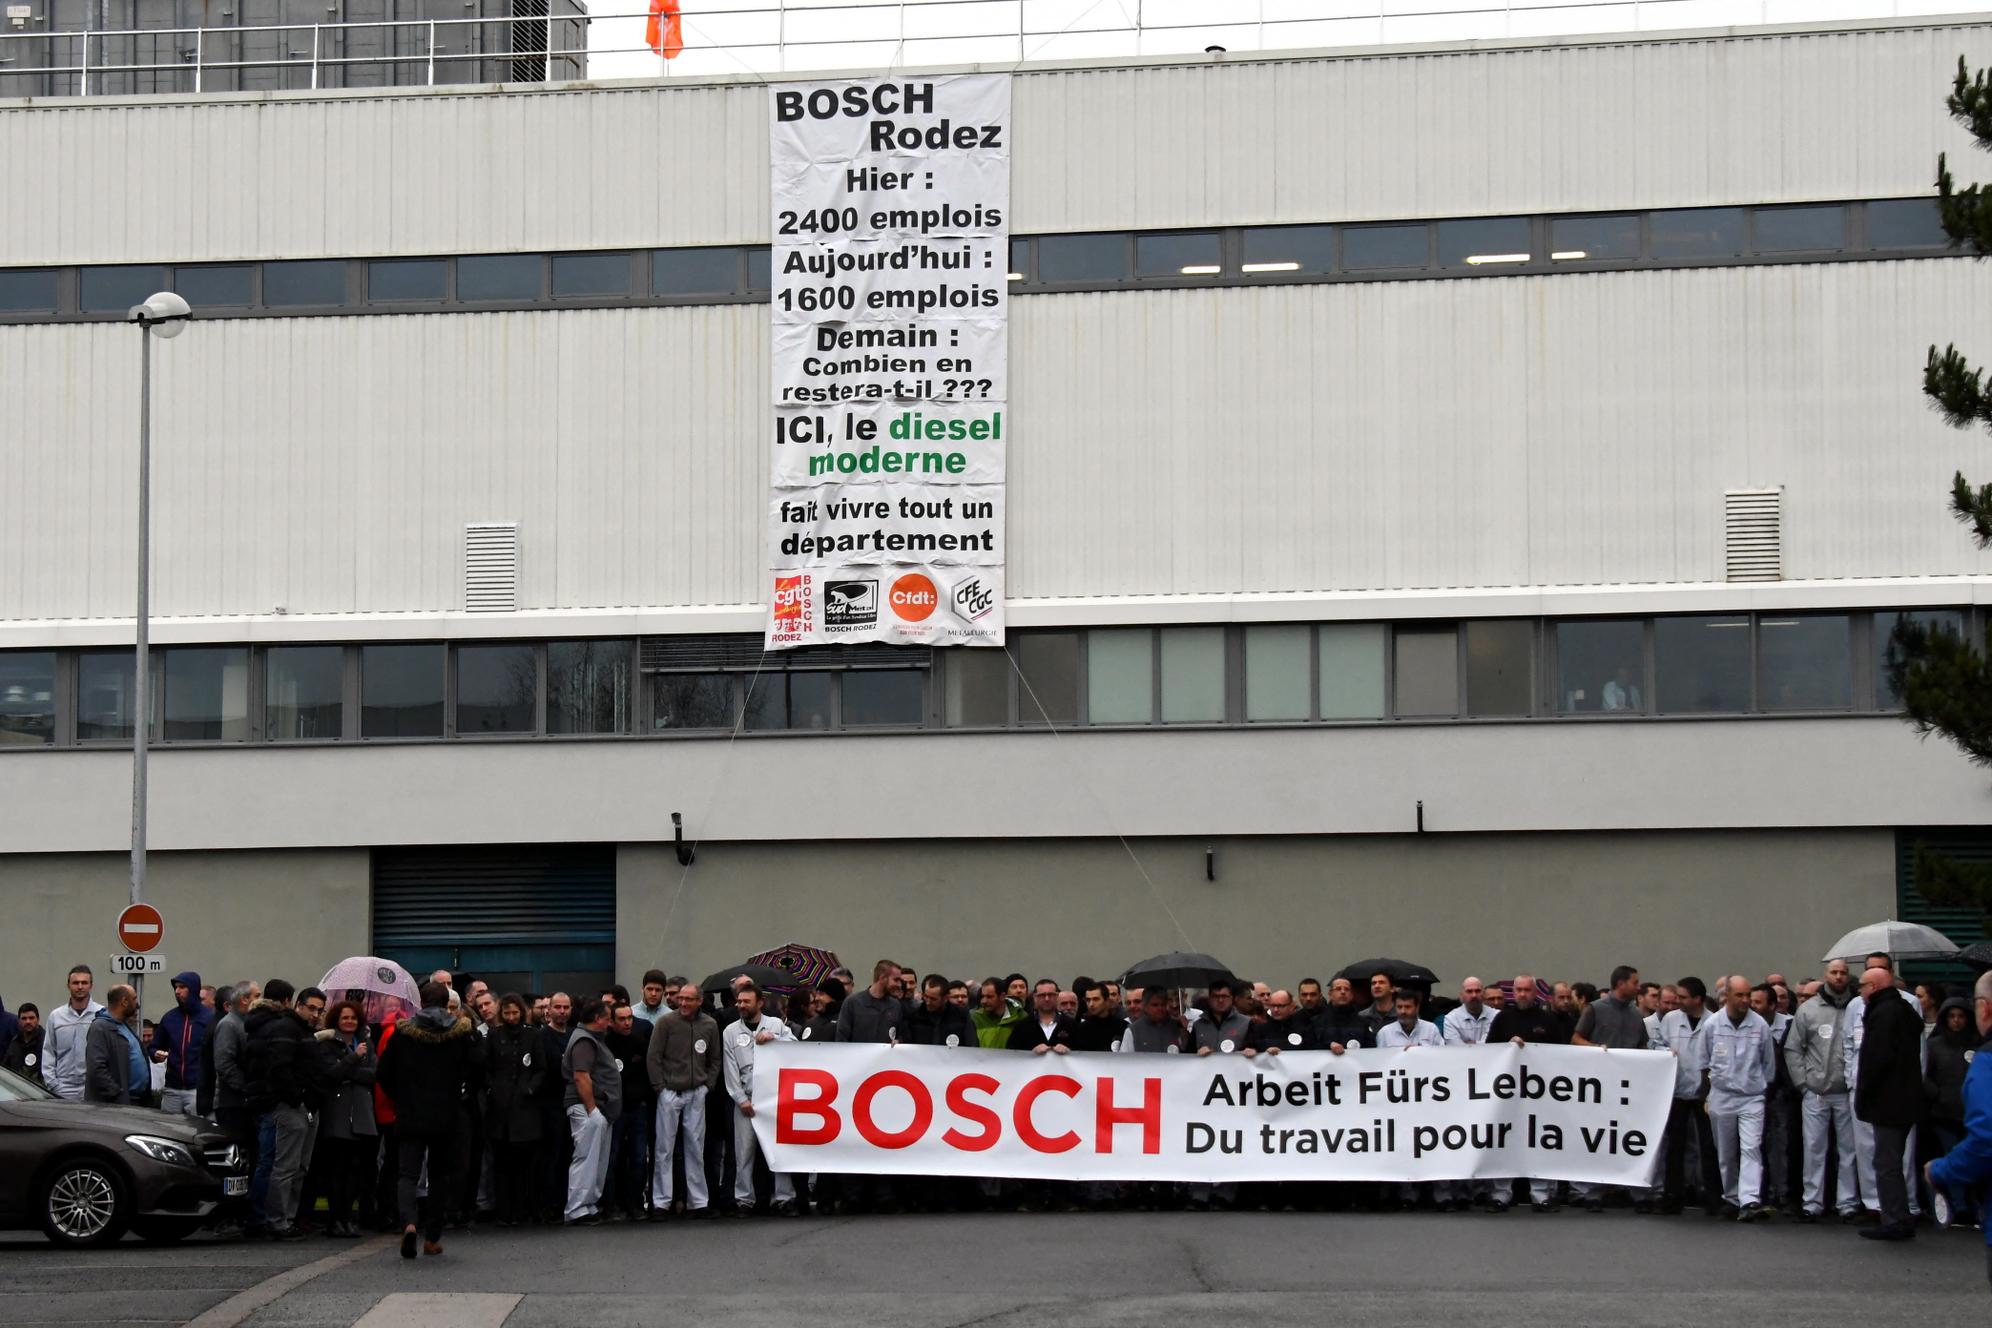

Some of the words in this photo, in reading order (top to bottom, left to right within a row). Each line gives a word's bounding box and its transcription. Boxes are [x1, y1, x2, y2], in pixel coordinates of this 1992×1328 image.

[776, 83, 934, 122] BOSCH
[870, 119, 1002, 152] Rodez
[846, 167, 915, 193] Hier
[925, 172, 934, 190] :
[778, 207, 858, 235] 2400
[870, 203, 1002, 234] emplois
[783, 245, 971, 278] Aujourd'hui
[984, 251, 992, 268] :
[777, 285, 855, 312] 1600
[866, 284, 999, 314] emplois
[817, 324, 937, 352] Demain
[950, 329, 959, 347] :
[802, 354, 926, 376] Combien
[936, 358, 972, 373] en
[782, 380, 932, 402] restera-t-il
[942, 379, 992, 399] ???
[776, 416, 833, 448] ICI,
[846, 412, 878, 441] le
[889, 412, 1001, 441] diesel
[809, 445, 967, 477] moderne
[780, 500, 818, 523] fait
[826, 498, 890, 520] vivre
[899, 497, 953, 520] tout
[962, 501, 993, 519] un
[780, 529, 993, 558] département
[775, 584, 802, 606] cgt
[803, 575, 812, 632] BOSCH
[956, 579, 981, 605] CFE
[968, 589, 993, 614] CGC
[771, 633, 802, 642] RODEZ
[853, 623, 877, 631] RODEZ
[118, 956, 145, 971] 100
[150, 960, 161, 970] m
[1202, 1071, 1342, 1107] Arbeit
[1358, 1069, 1450, 1105] Fürs
[1467, 1065, 1602, 1104] Leben
[1620, 1079, 1630, 1106] :
[775, 1067, 1162, 1155] BOSCH
[1186, 1121, 1244, 1155] Du
[1260, 1118, 1395, 1155] travail
[1413, 1121, 1512, 1158] pour
[1527, 1114, 1563, 1151] la
[1581, 1119, 1647, 1157] vie
